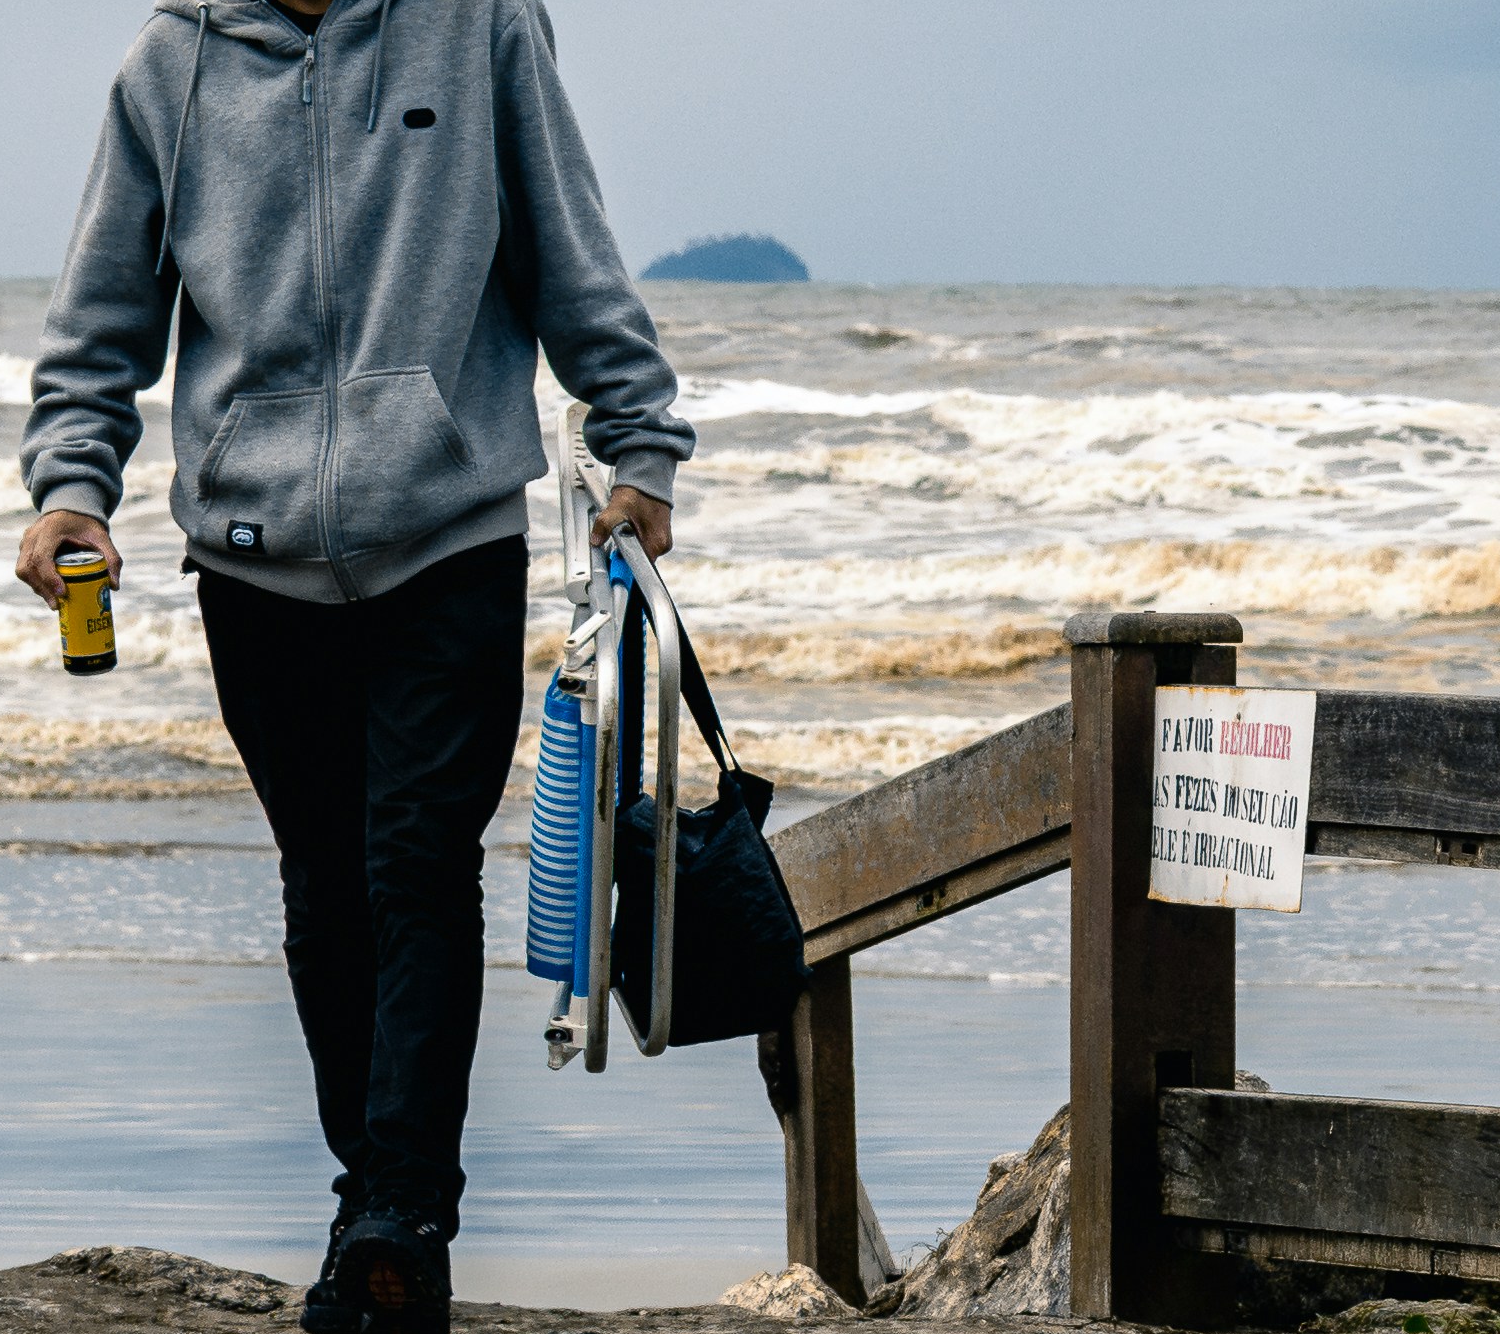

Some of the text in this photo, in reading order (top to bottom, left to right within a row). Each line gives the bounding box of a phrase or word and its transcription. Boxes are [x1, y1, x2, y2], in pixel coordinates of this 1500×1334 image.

[1161, 716, 1292, 761] FAVOR RECOLHER
[1153, 775, 1170, 808] AS
[1174, 774, 1219, 813] FEZES
[1152, 817, 1275, 881] ELE É IRRACIONAL
